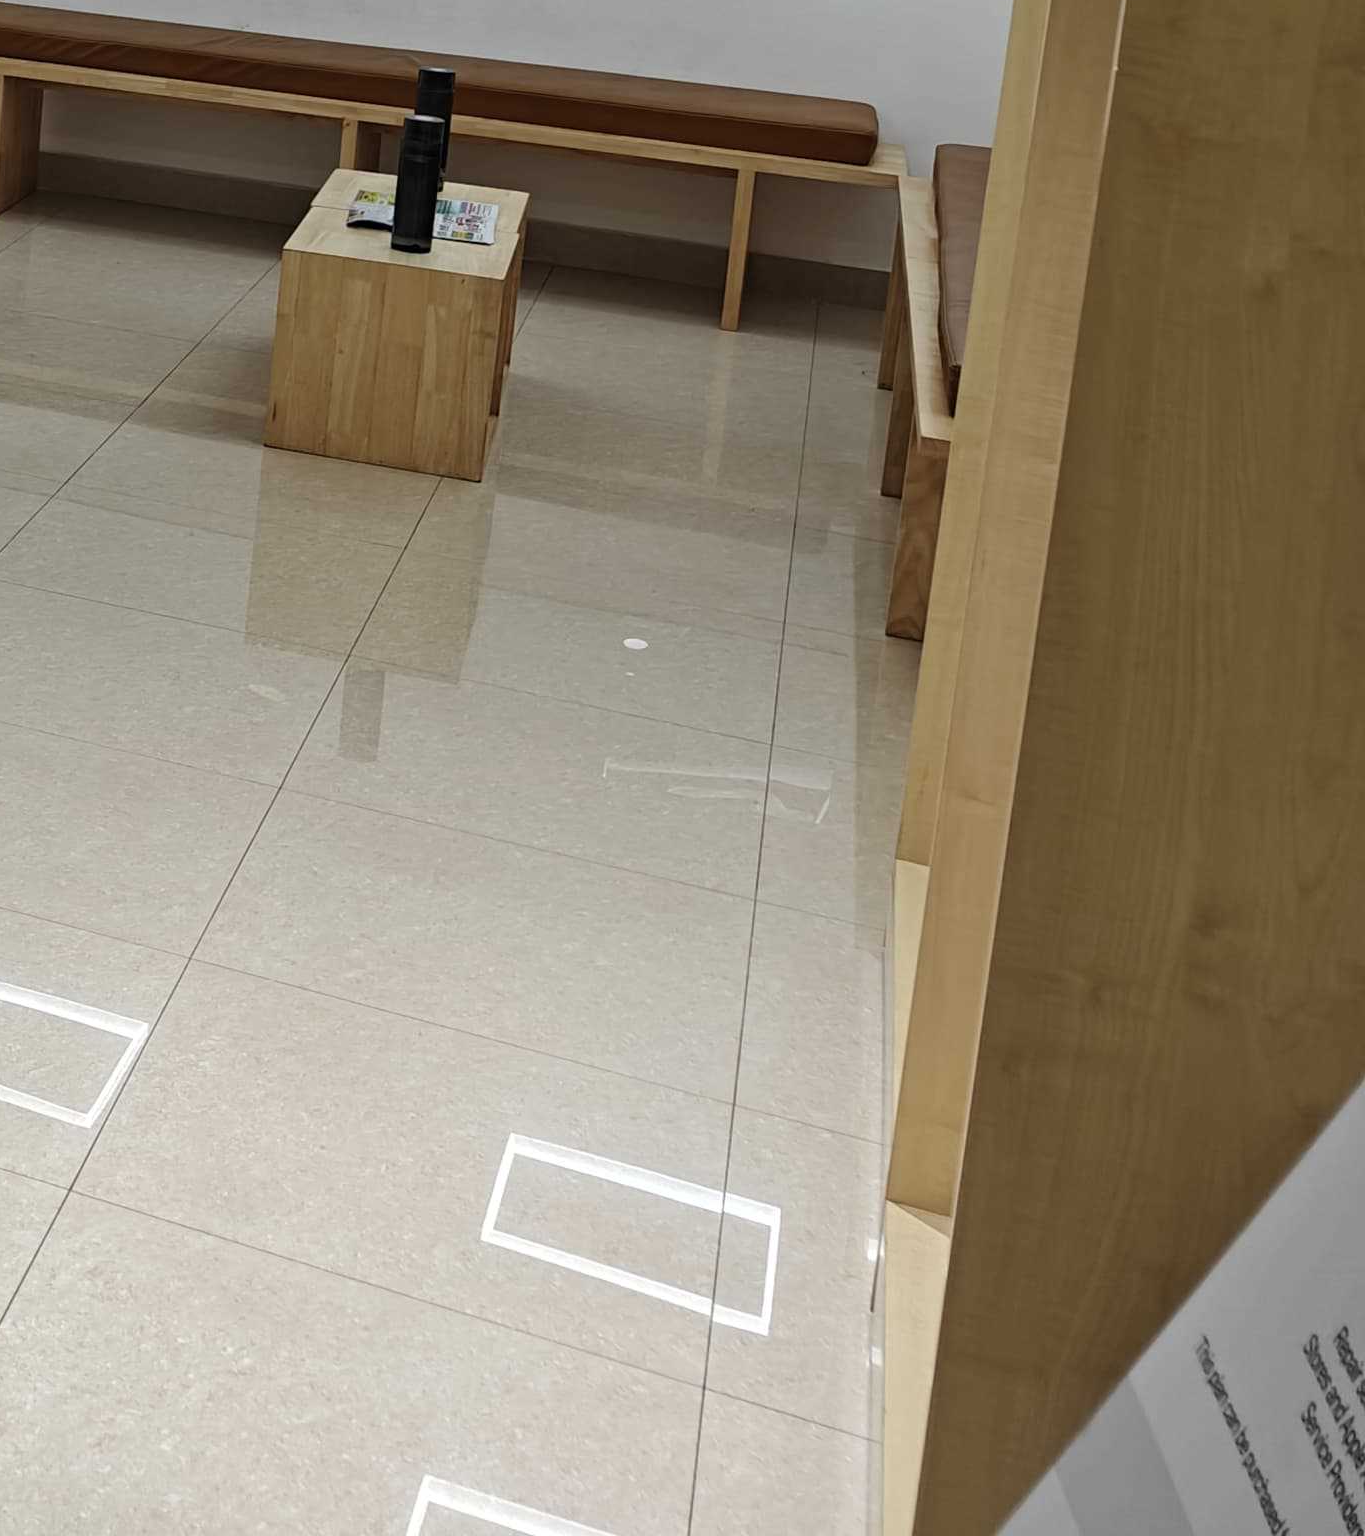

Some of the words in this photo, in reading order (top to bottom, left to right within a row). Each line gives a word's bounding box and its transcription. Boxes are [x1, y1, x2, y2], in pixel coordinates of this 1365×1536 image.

[1303, 1333, 1332, 1392] Stores
[1325, 1385, 1350, 1424] and
[1340, 1415, 1365, 1470] Apple
[1333, 1325, 1364, 1383] Repair
[1195, 1333, 1215, 1376] This
[1207, 1370, 1229, 1407] plan
[1222, 1402, 1241, 1436] can
[1234, 1426, 1250, 1456] be
[1242, 1451, 1286, 1536] purchased
[1301, 1400, 1333, 1470] Service
